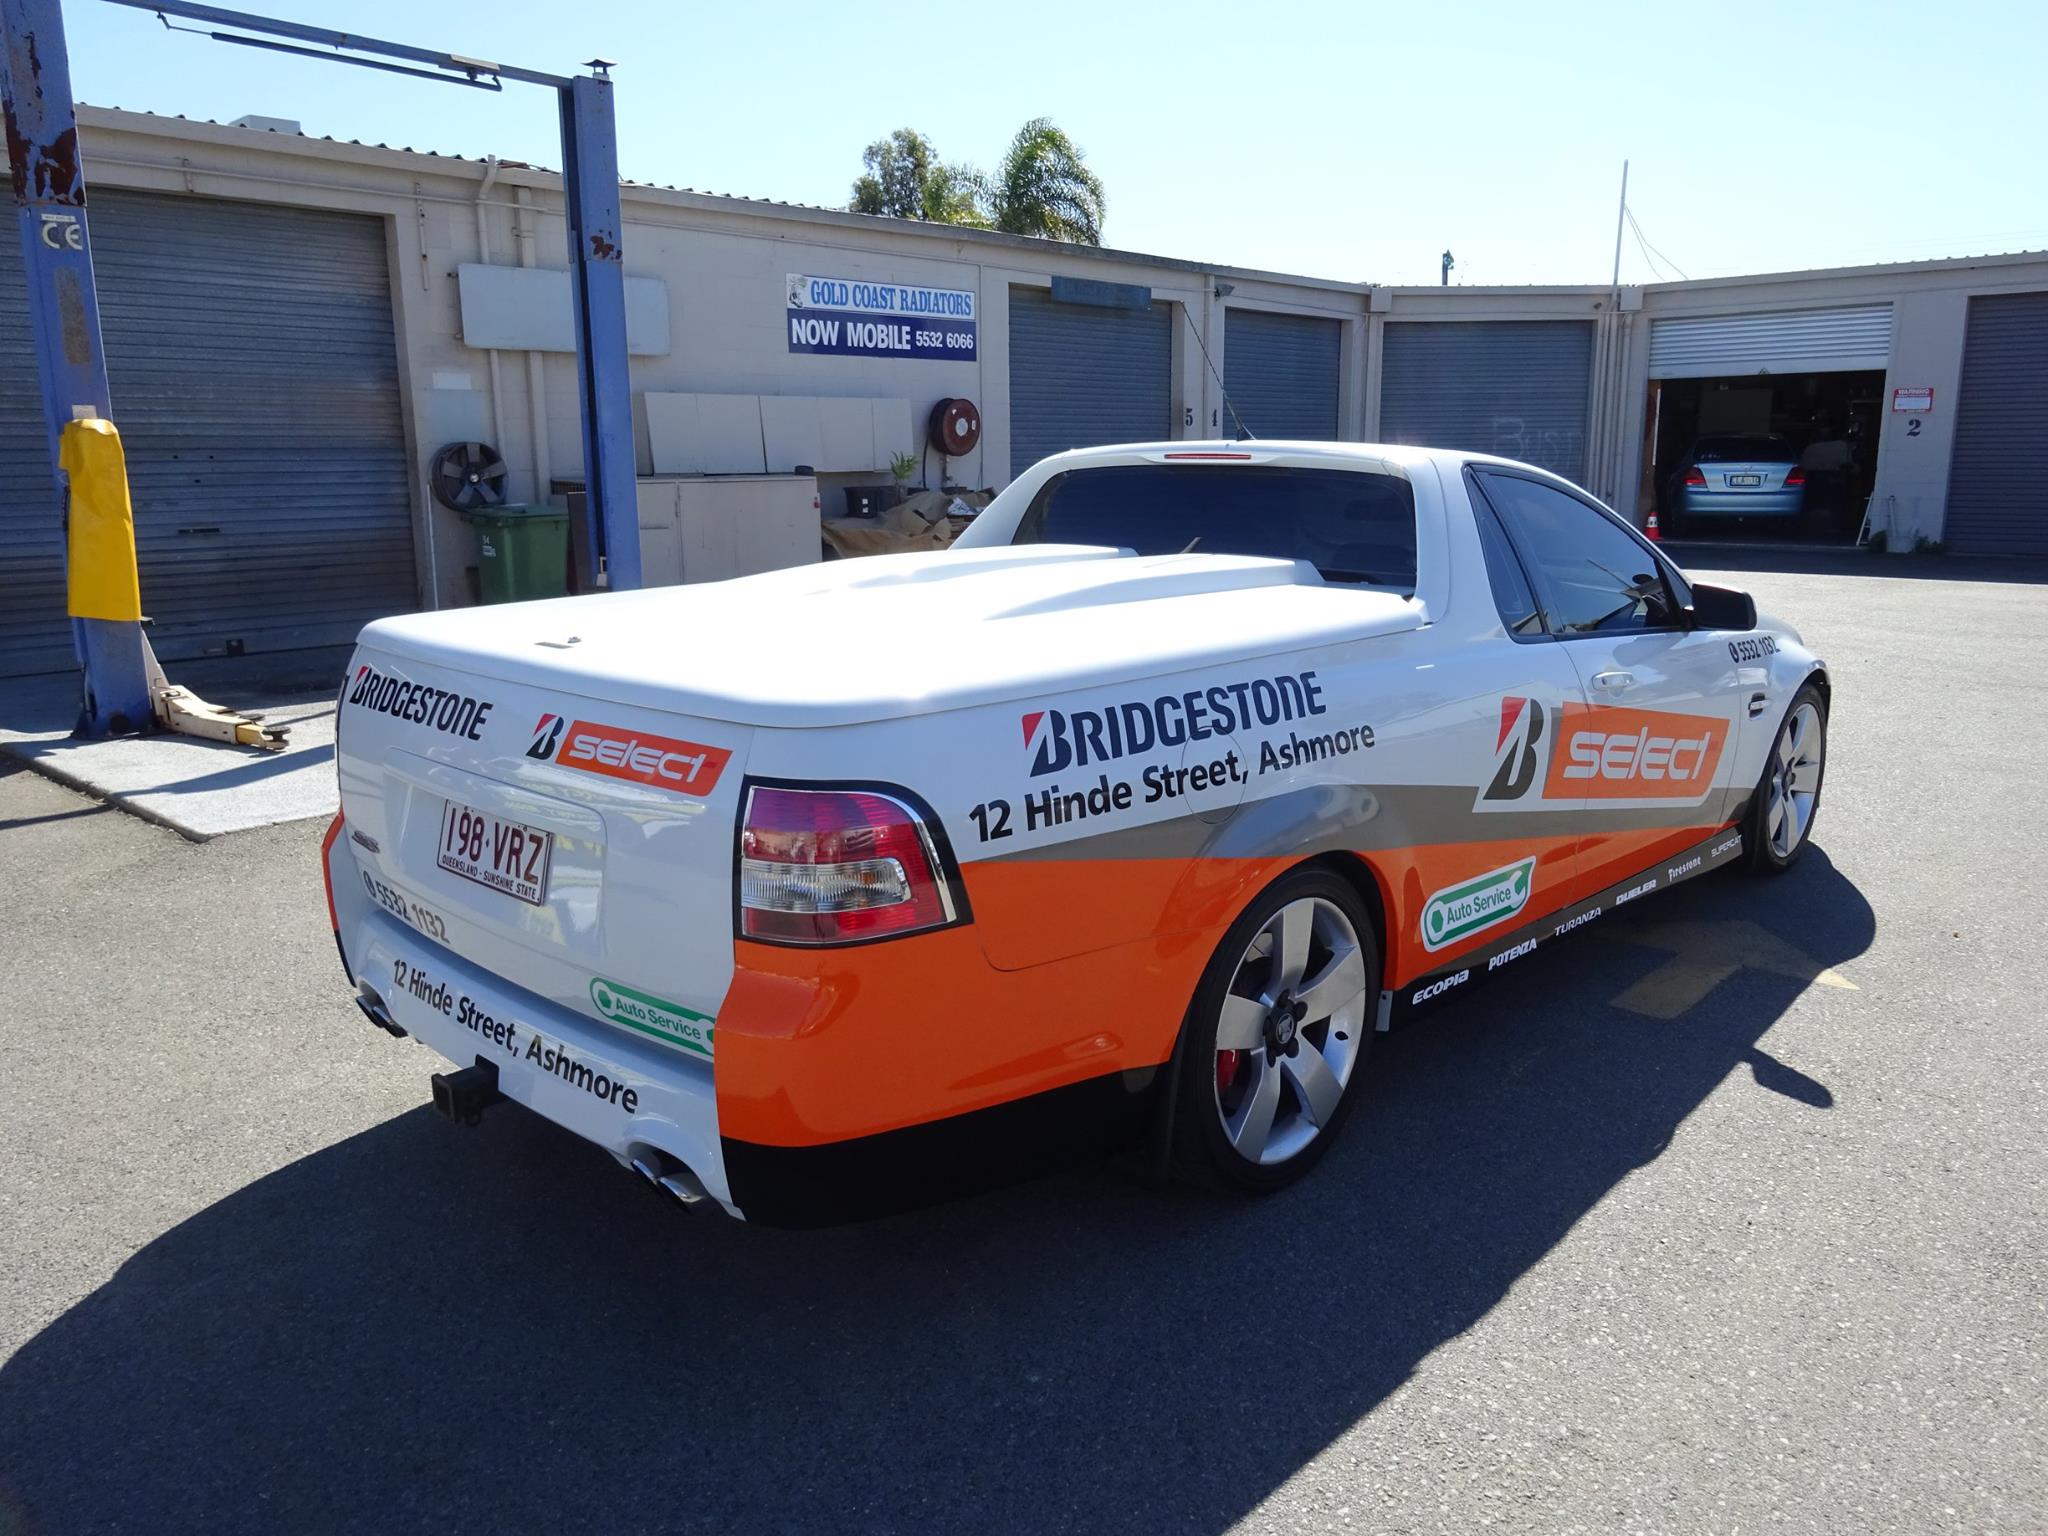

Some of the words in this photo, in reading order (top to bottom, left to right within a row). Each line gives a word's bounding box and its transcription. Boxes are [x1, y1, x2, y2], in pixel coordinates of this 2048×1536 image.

[42, 222, 83, 250] CE
[810, 280, 848, 306] GOLD
[852, 285, 896, 310] COAST
[900, 289, 972, 316] RADIATORS
[792, 318, 839, 346] NOW
[847, 322, 911, 350] MOBILE
[916, 331, 943, 348] 5532
[946, 333, 974, 349] 6066
[1185, 408, 1194, 427] 5
[1906, 419, 1922, 437] 2
[1737, 639, 1761, 661] 5532
[1758, 635, 1781, 655] 1132
[349, 665, 494, 741] BRIDGESTONE
[1021, 671, 1327, 778] BRIDGESTONE
[969, 799, 1013, 843] 12
[1024, 775, 1133, 832] Hinde
[1143, 750, 1249, 804] Street,
[1259, 725, 1376, 776] Ashmore
[442, 855, 478, 877] QUEENSLAND
[483, 870, 514, 891] SUNSHINE
[516, 883, 536, 899] STATE
[375, 880, 412, 922] 5532
[411, 903, 450, 944] 1132
[1447, 903, 1472, 926] Auto
[1473, 888, 1512, 915] Service
[1412, 969, 1470, 1006] ECOPIA
[1488, 938, 1537, 971] POTENZA
[1555, 907, 1602, 937] TURANZA
[1616, 879, 1657, 905] DUELER
[1668, 856, 1702, 883] Firestone
[394, 959, 407, 988] 12
[410, 966, 452, 1015] Hinde
[457, 996, 520, 1057] Street,
[525, 1035, 639, 1115] Ashmore
[616, 998, 646, 1021] Auto
[649, 1009, 701, 1040] Service
